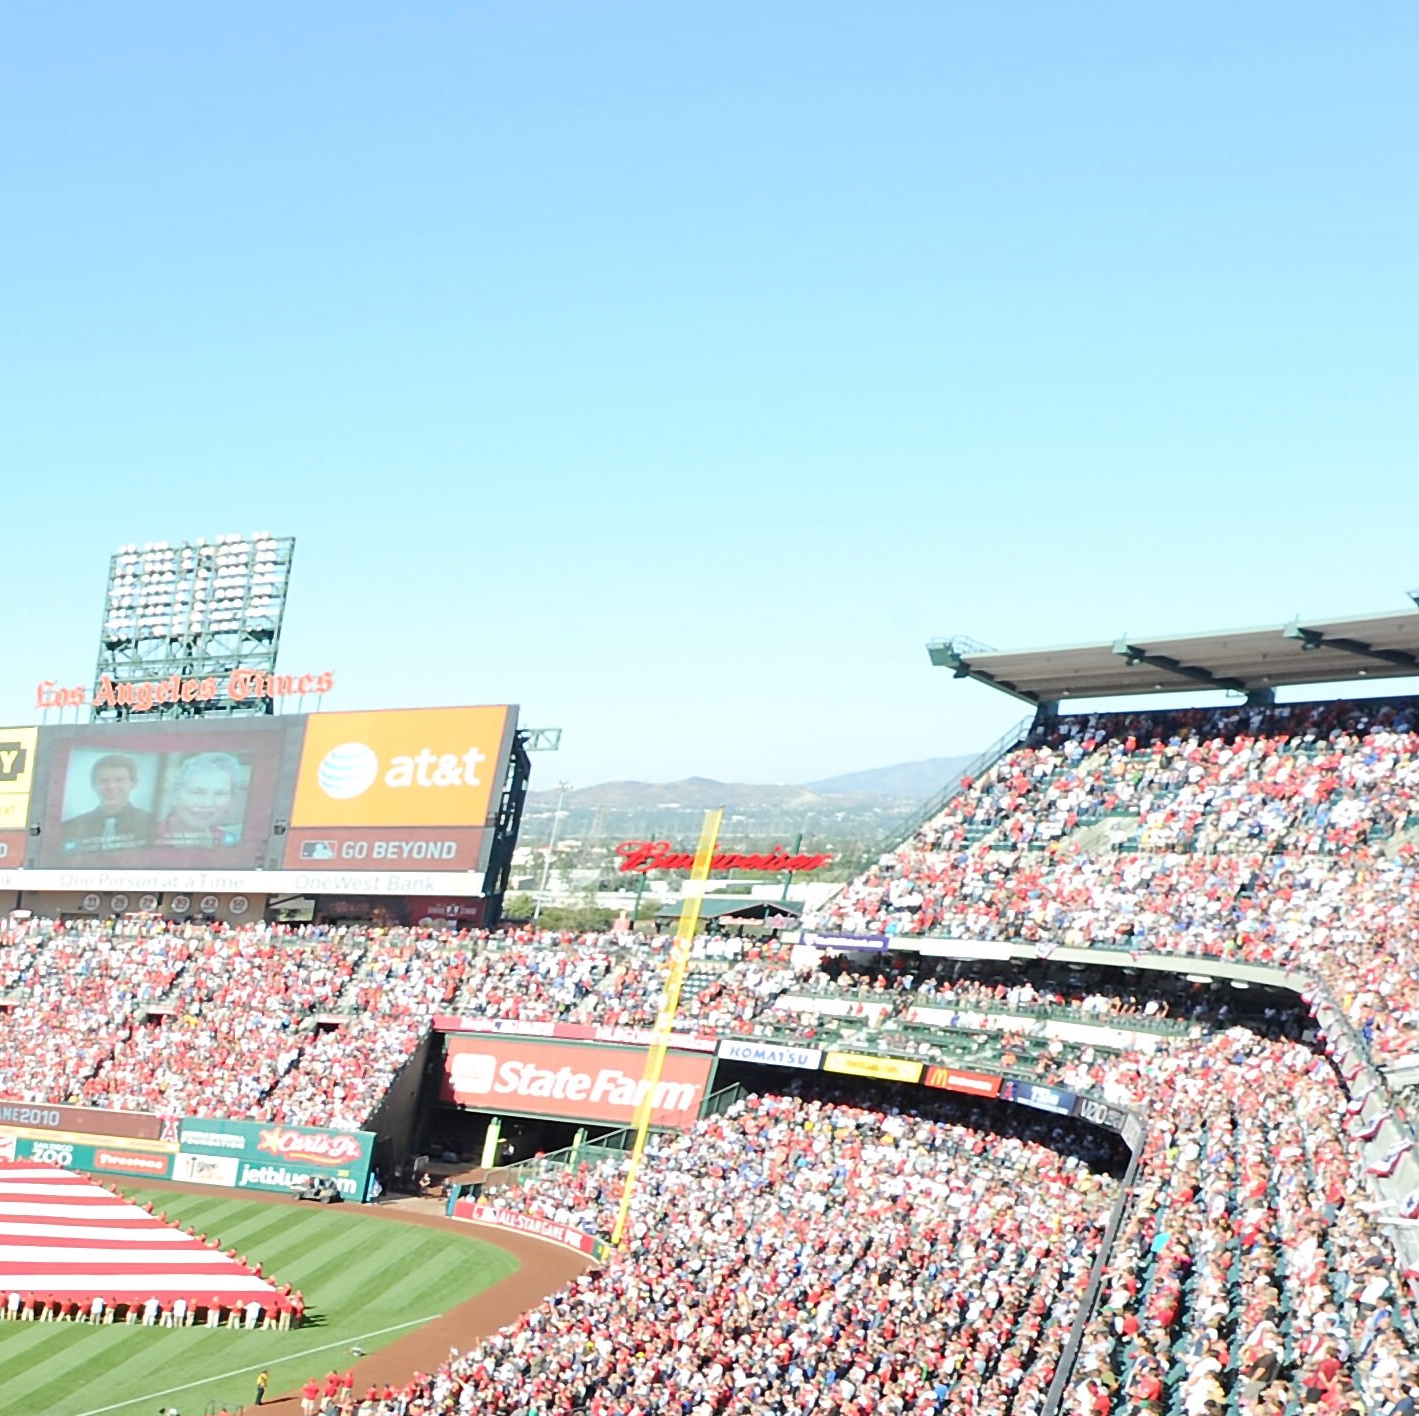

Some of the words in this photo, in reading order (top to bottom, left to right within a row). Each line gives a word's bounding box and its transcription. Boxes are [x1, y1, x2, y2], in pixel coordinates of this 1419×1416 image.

[35, 680, 86, 709] Los
[91, 675, 217, 712] Angeles
[227, 668, 335, 702] Times
[384, 747, 485, 788] at&t
[342, 842, 367, 859] GO
[373, 841, 457, 859] BEYOND
[60, 873, 93, 888] One
[98, 873, 158, 889] Person
[199, 874, 244, 889] Time
[295, 874, 380, 892] OneWest
[386, 874, 436, 892] Bank
[729, 1047, 809, 1065] KOMATSU
[494, 1060, 592, 1100] State
[20, 1109, 60, 1126] 2010
[278, 1132, 330, 1154] Carl's
[34, 1149, 72, 1166] ZOO
[99, 1154, 163, 1170] Firestone
